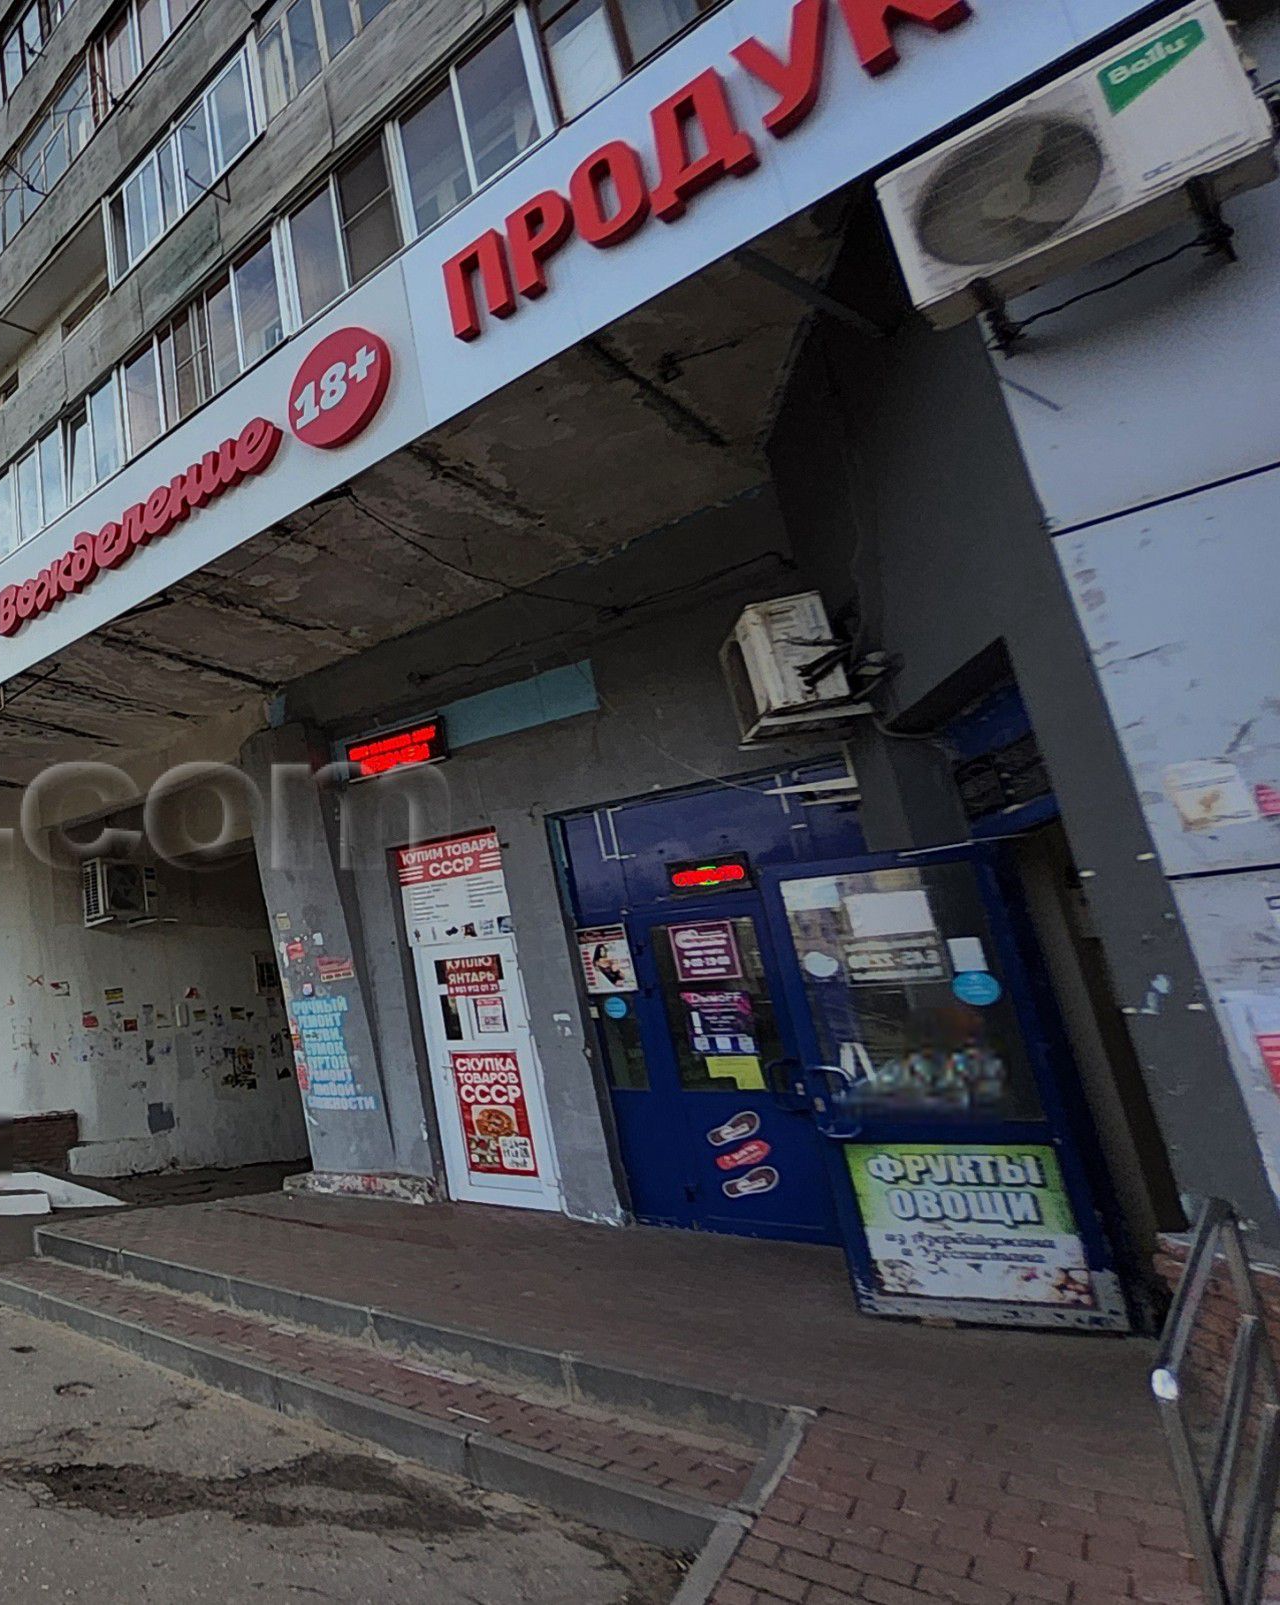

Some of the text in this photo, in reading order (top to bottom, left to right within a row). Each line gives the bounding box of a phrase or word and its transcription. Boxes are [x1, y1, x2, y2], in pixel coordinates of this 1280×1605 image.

[293, 344, 376, 431] 18+
[401, 835, 500, 866] КУПИМ ТОВАРЫ
[428, 857, 474, 877] СССР
[448, 971, 496, 985] ЯНТАРЬ
[455, 1057, 517, 1071] СКУПКА
[457, 1072, 519, 1084] ТОВАРОВ
[460, 1084, 522, 1104] СССР
[867, 1152, 1046, 1188] ФРУКТЫ
[886, 1187, 1044, 1229] ОВОЩИ
